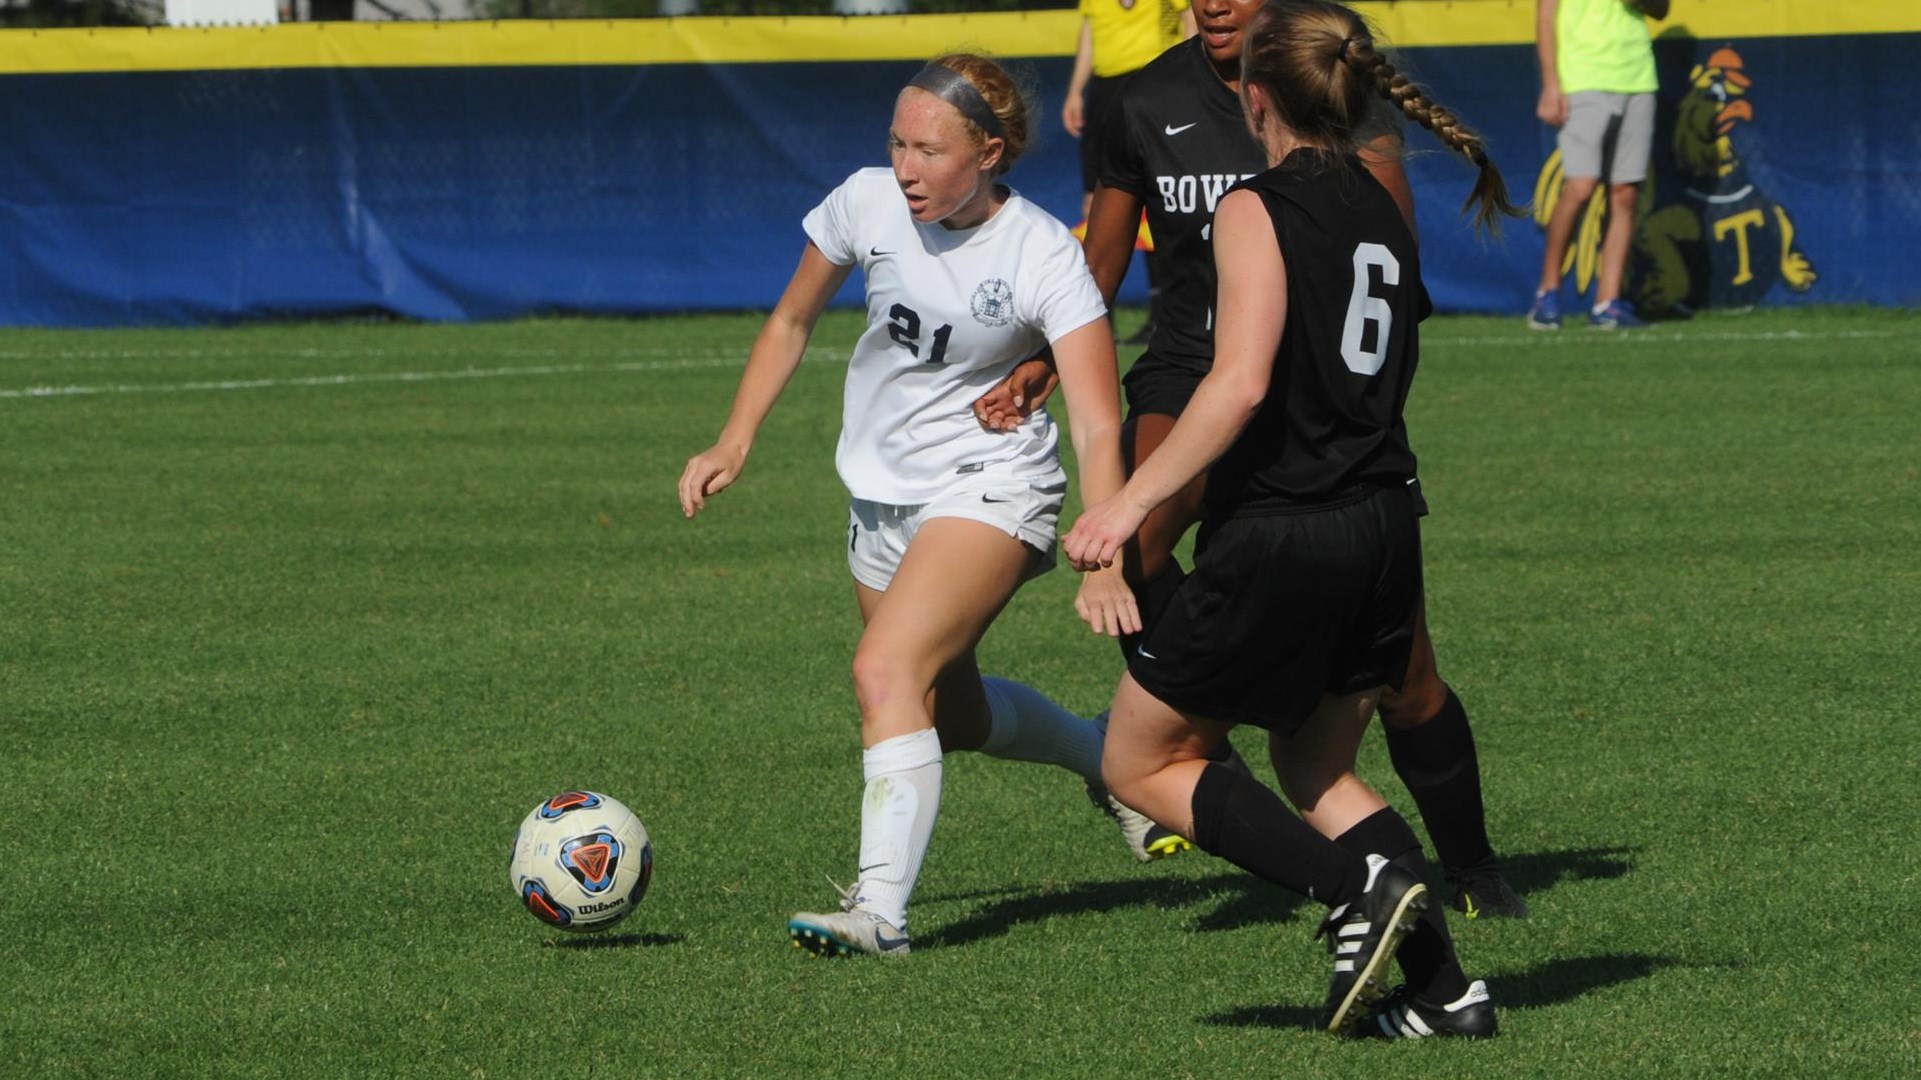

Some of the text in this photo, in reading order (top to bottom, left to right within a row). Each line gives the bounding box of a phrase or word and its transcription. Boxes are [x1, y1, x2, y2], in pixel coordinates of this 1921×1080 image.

[1156, 174, 1257, 213] BOW
[1713, 209, 1765, 286] T
[887, 302, 953, 363] 21
[1340, 242, 1399, 375] 6
[578, 898, 624, 914] Wilson
